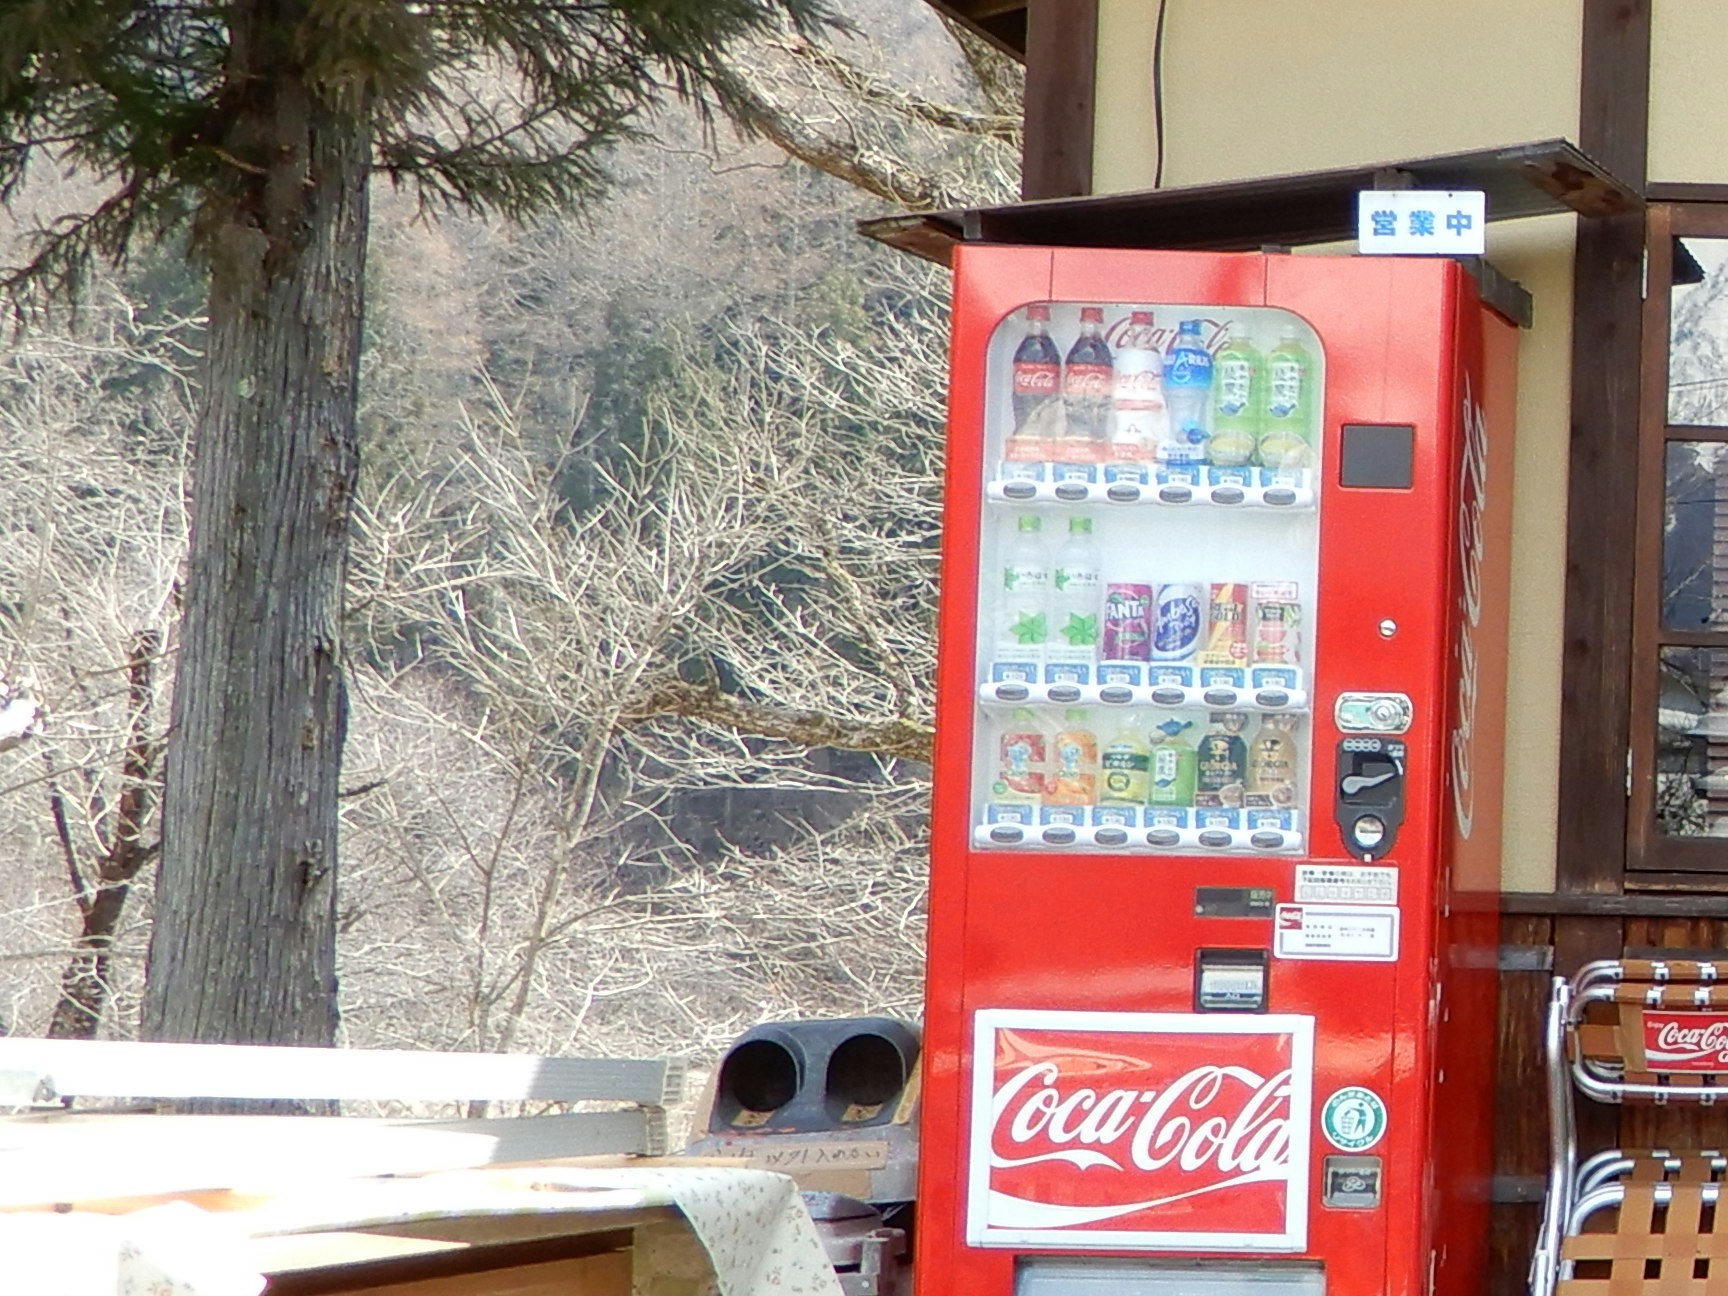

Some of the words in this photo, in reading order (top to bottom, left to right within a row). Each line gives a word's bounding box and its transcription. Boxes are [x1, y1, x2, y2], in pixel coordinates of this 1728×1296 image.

[1370, 209, 1473, 237] 営業中
[991, 1060, 1296, 1173] Coca-Cola
